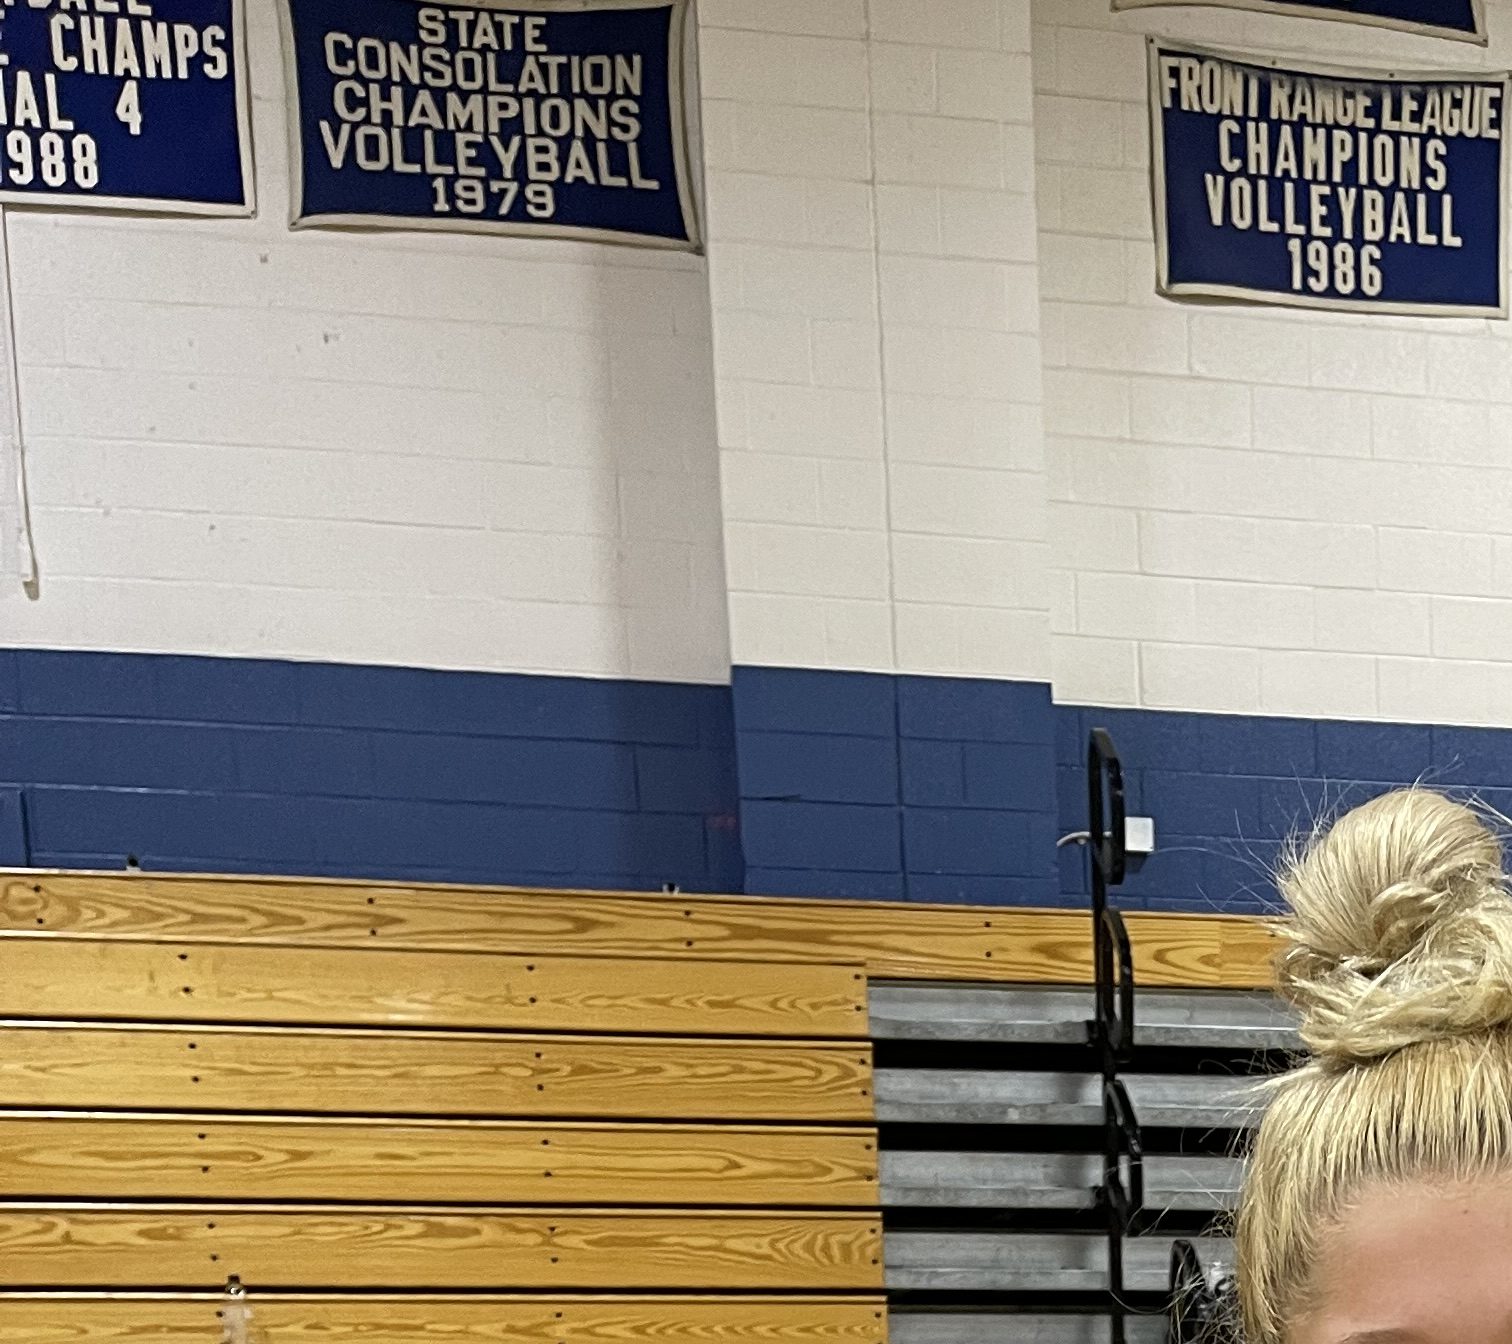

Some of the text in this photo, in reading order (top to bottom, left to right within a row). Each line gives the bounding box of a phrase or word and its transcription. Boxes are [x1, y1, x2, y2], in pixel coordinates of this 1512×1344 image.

[51, 13, 228, 79] CHAMPS
[418, 7, 548, 52] STATE
[324, 31, 642, 96] CONSOLATION
[115, 80, 142, 135] 4
[333, 80, 641, 142] CHAMPIONS
[1160, 55, 1501, 139] FRONT RANGE LEAGUE
[0, 129, 98, 189] 988
[319, 120, 660, 190] VOLLEYBALL
[1219, 119, 1447, 191] CHAMPIONS
[432, 177, 556, 218] 1979
[1204, 173, 1463, 248] VOLLEYBALL
[1287, 238, 1382, 296] 1986
